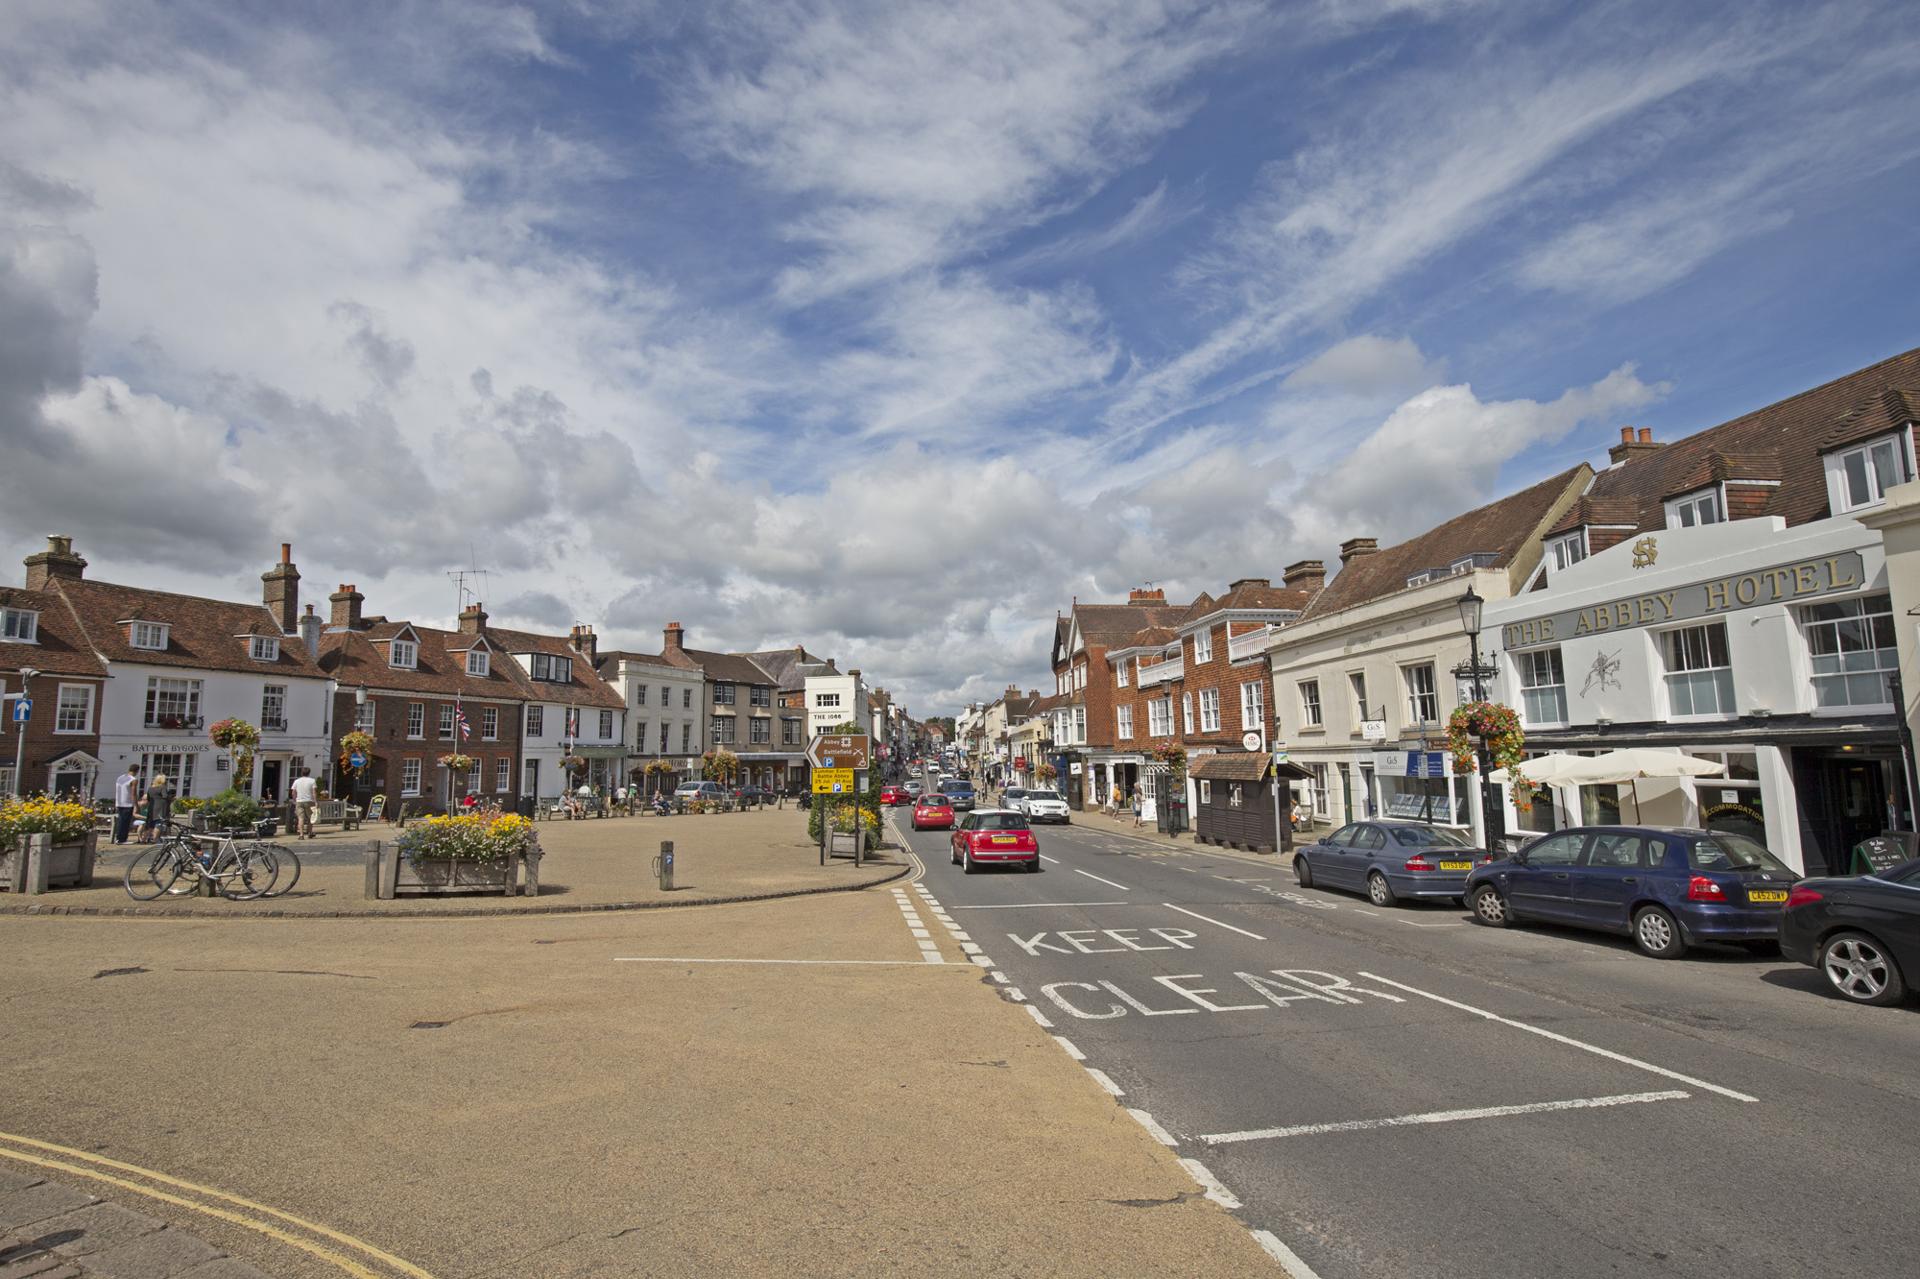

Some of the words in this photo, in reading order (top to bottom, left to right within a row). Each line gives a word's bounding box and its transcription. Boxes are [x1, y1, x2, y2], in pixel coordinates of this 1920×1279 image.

[1504, 619, 1555, 647] THE
[1574, 592, 1679, 635] ABBEY
[1704, 559, 1856, 613] HOTEL
[132, 744, 168, 752] BATTLE
[171, 744, 209, 752] BYGONES
[1007, 927, 1198, 956] KEEP
[1040, 969, 1408, 1020] CLEAR
